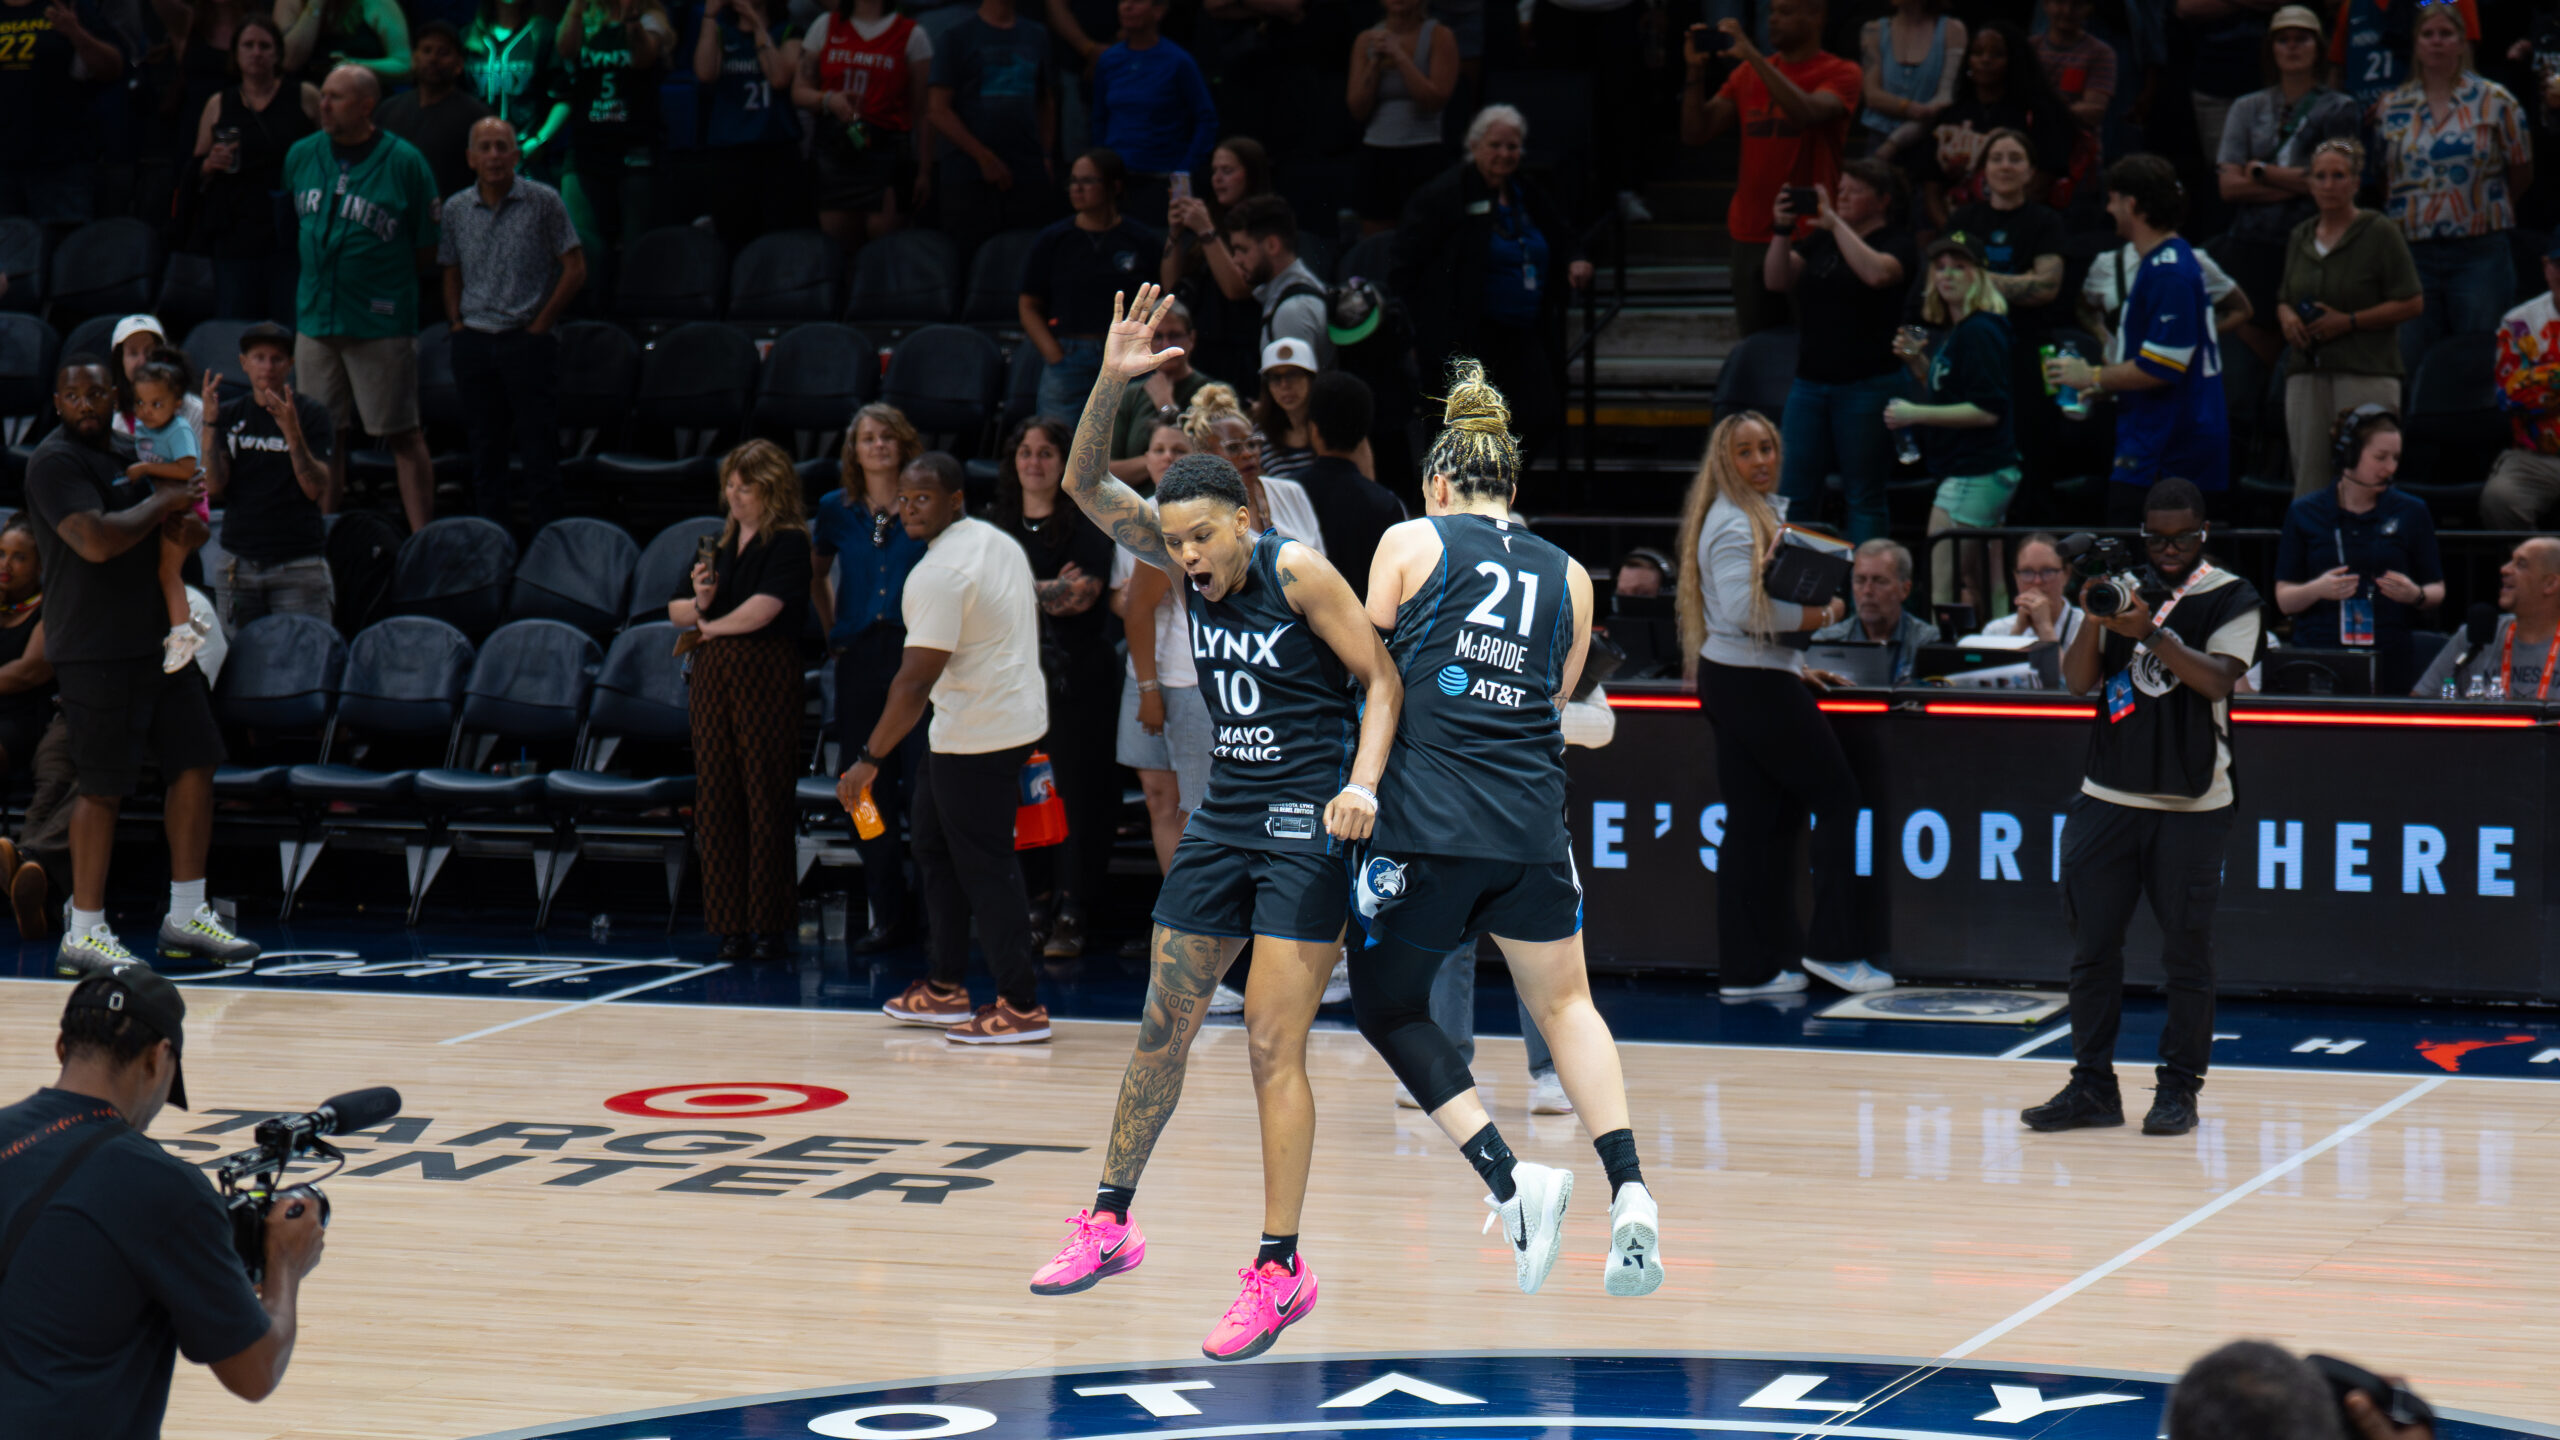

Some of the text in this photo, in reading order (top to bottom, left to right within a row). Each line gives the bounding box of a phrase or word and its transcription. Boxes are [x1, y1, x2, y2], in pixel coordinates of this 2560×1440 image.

[0, 33, 37, 61] 22
[827, 48, 896, 70] ATLANTA
[2363, 50, 2393, 82] 21
[600, 71, 616, 99] 5
[744, 80, 771, 110] 21
[1464, 559, 1540, 640] 21
[1189, 610, 1297, 669] LYNX
[1454, 629, 1529, 675] McBRIDE
[1213, 670, 1261, 717] 10
[1469, 677, 1527, 709] AT&T
[1219, 725, 1275, 745] MAYO
[2257, 820, 2515, 897] HERE
[185, 1108, 1091, 1170] TARGET
